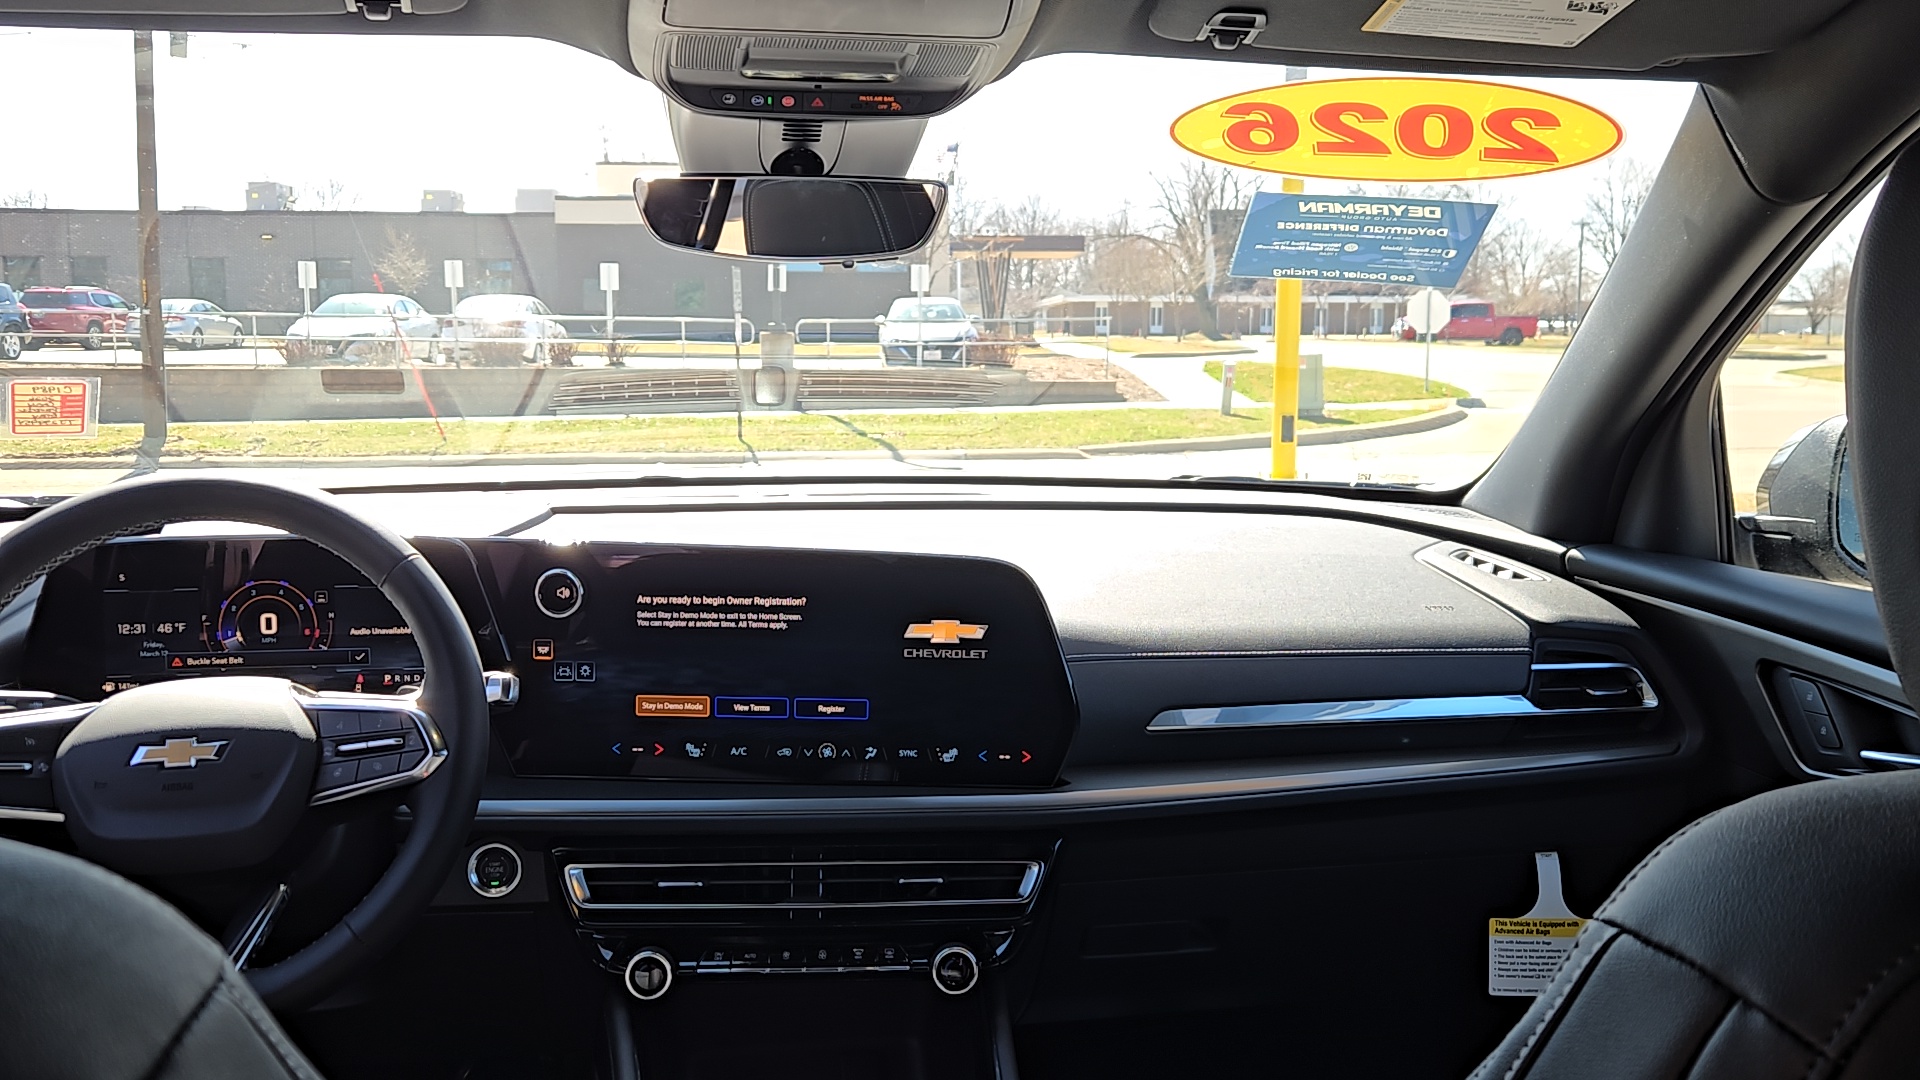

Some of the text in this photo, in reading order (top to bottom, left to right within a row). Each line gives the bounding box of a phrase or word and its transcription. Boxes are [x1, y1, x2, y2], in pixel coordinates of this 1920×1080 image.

[278, 588, 284, 596] 4
[636, 595, 807, 607] Are you ready to begin Owner Registration?
[637, 610, 657, 618] Select
[658, 611, 672, 620] Stay
[700, 612, 718, 620] Mode
[718, 612, 726, 620] to
[727, 612, 738, 620] exit
[739, 612, 746, 620] to
[747, 612, 758, 620] the
[758, 612, 778, 620] Home
[260, 612, 278, 634] 0
[663, 620, 687, 628] register
[696, 620, 720, 628] another
[770, 622, 788, 630] apply.
[117, 624, 146, 634] 12:31
[350, 628, 371, 636] Audio
[903, 648, 989, 659] CHEVROLET
[187, 656, 244, 666] Buckle Seat Belt
[384, 674, 421, 682] P R N D
[641, 702, 704, 711] Stay in Demo Mode
[733, 704, 770, 712] View Terms
[817, 704, 846, 714] Register
[730, 746, 748, 756] A/C
[898, 749, 918, 758] SYNC
[485, 866, 504, 874] ENGINE
[1538, 920, 1566, 928] Equipped
[1536, 928, 1551, 936] Bags
